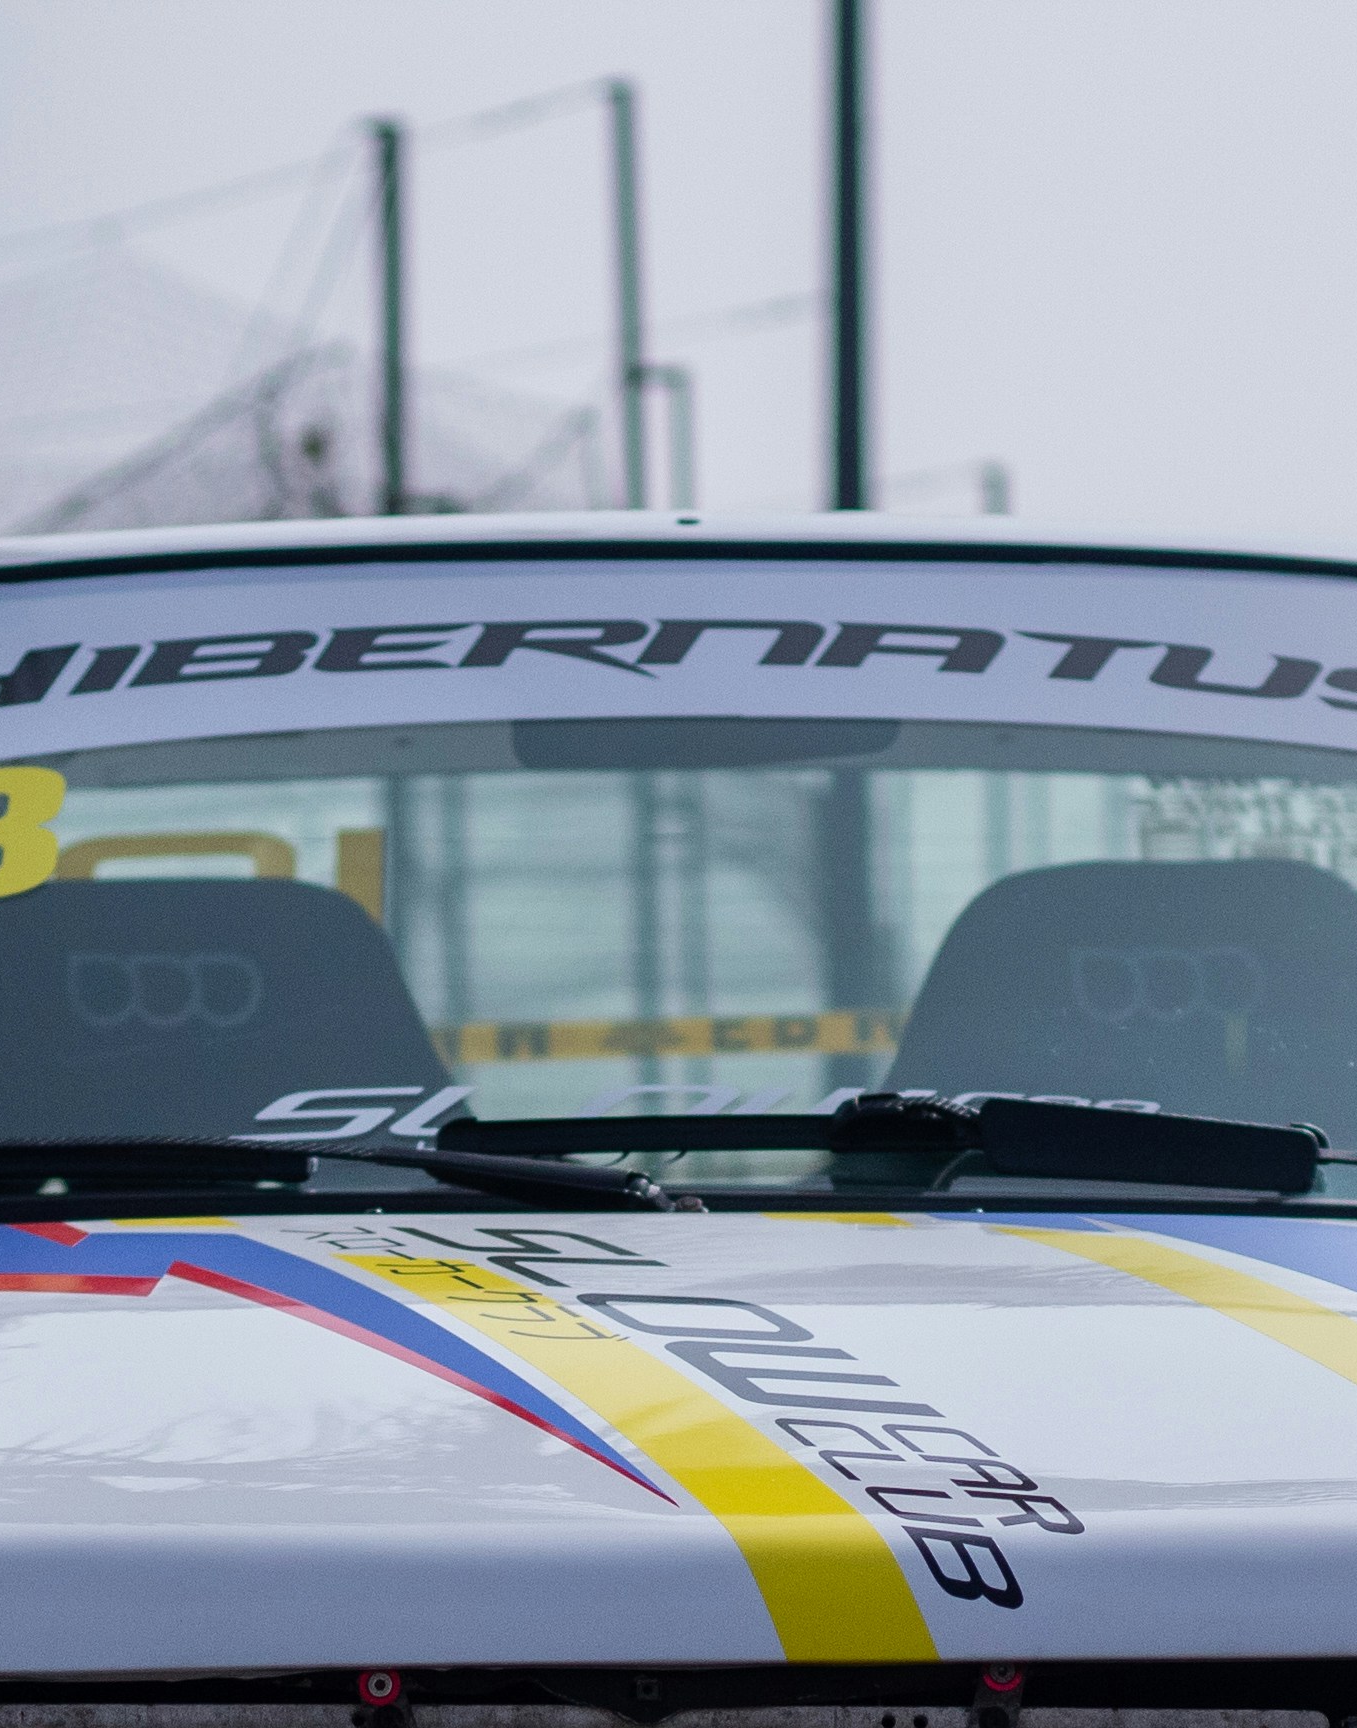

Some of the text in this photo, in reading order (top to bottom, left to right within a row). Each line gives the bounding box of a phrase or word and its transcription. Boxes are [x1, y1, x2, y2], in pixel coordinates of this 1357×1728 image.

[281, 1226, 631, 1342] スローカークラブ
[394, 1227, 1085, 1610] SLOW CAR CLUB
